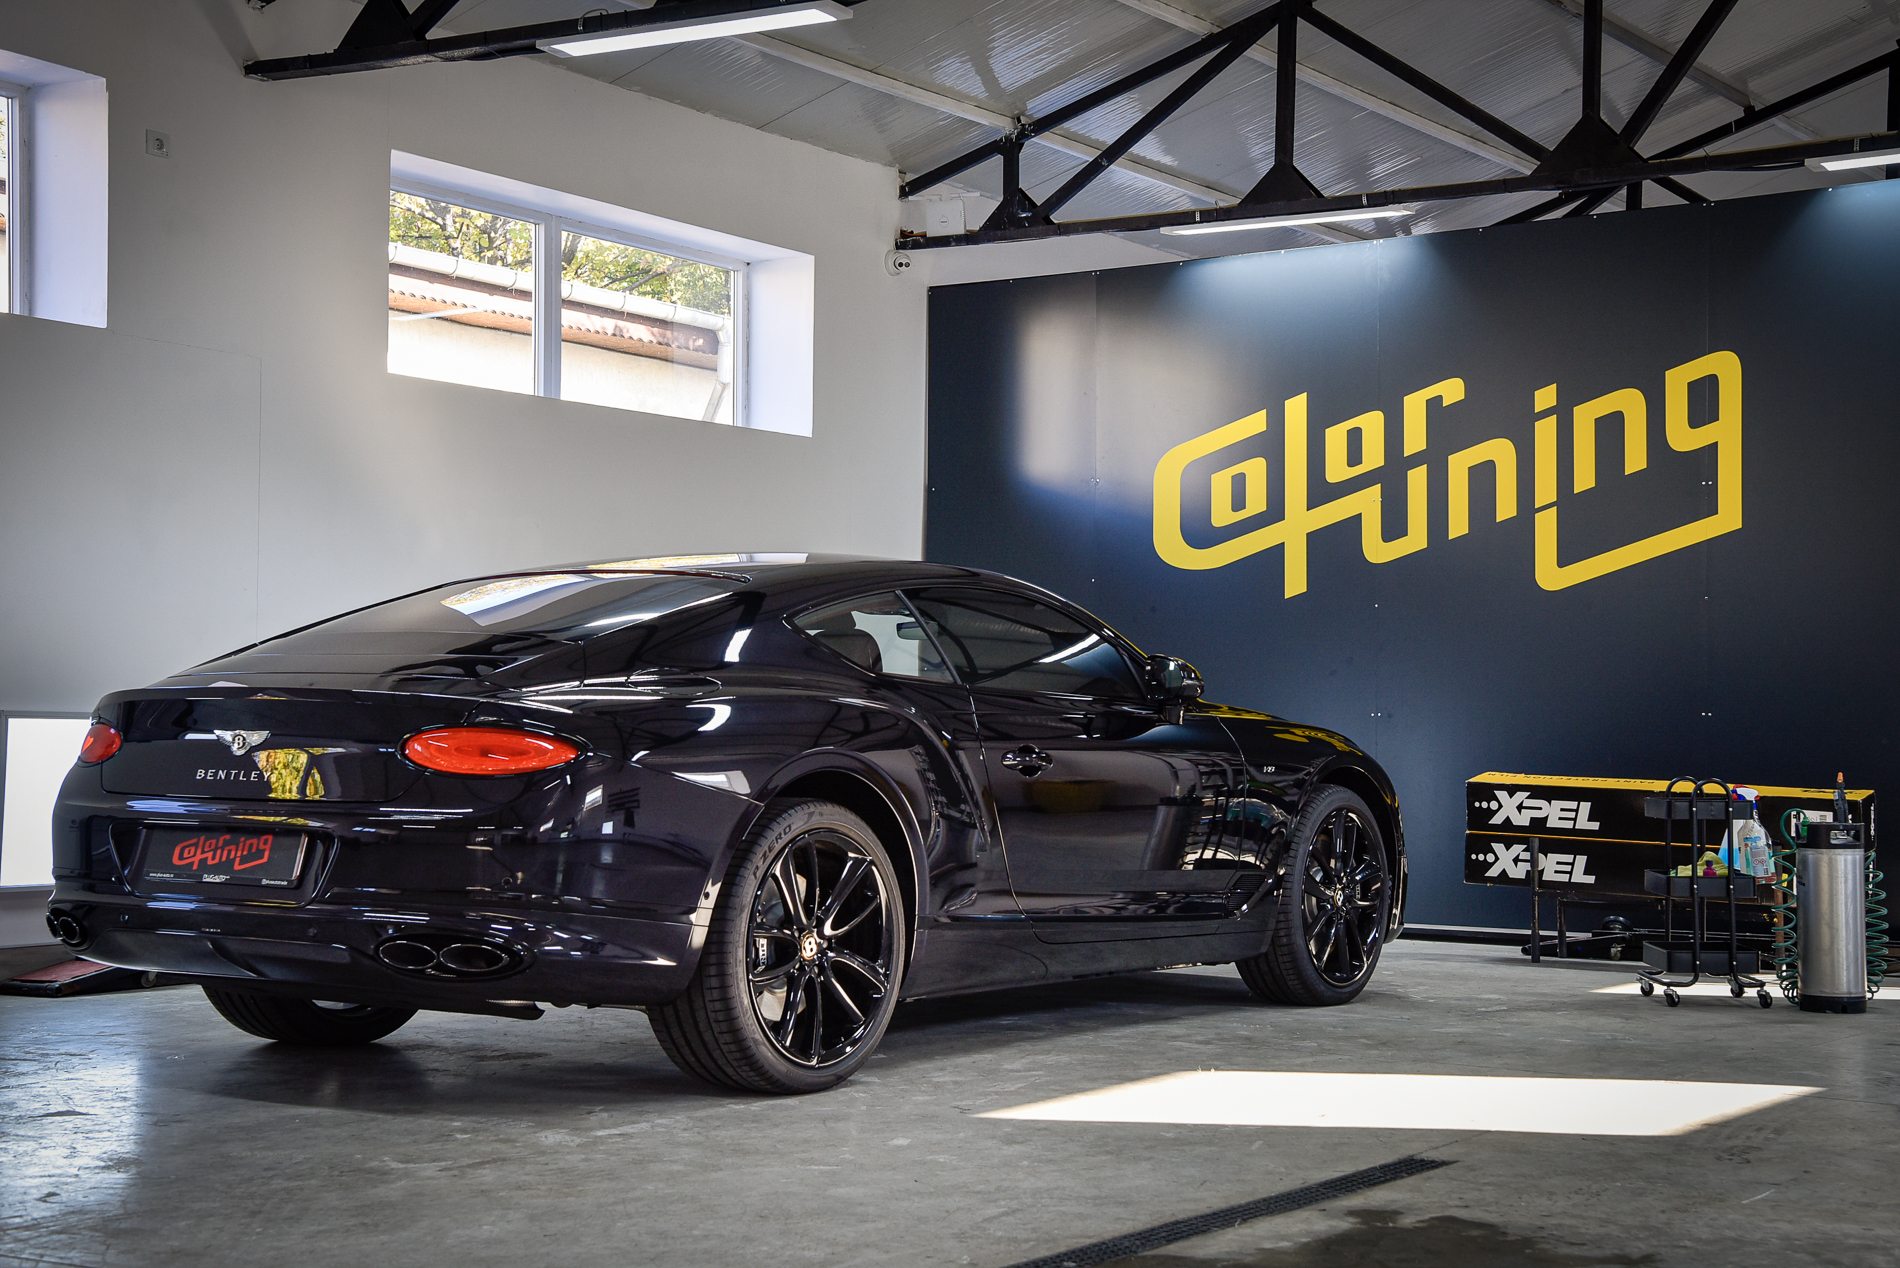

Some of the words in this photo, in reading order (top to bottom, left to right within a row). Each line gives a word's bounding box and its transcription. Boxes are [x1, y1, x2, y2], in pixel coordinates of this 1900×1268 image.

[195, 769, 272, 782] BENTLEY
[1488, 790, 1601, 831] XPEL
[760, 823, 793, 866] ZERO
[1484, 842, 1597, 884] XPEL
